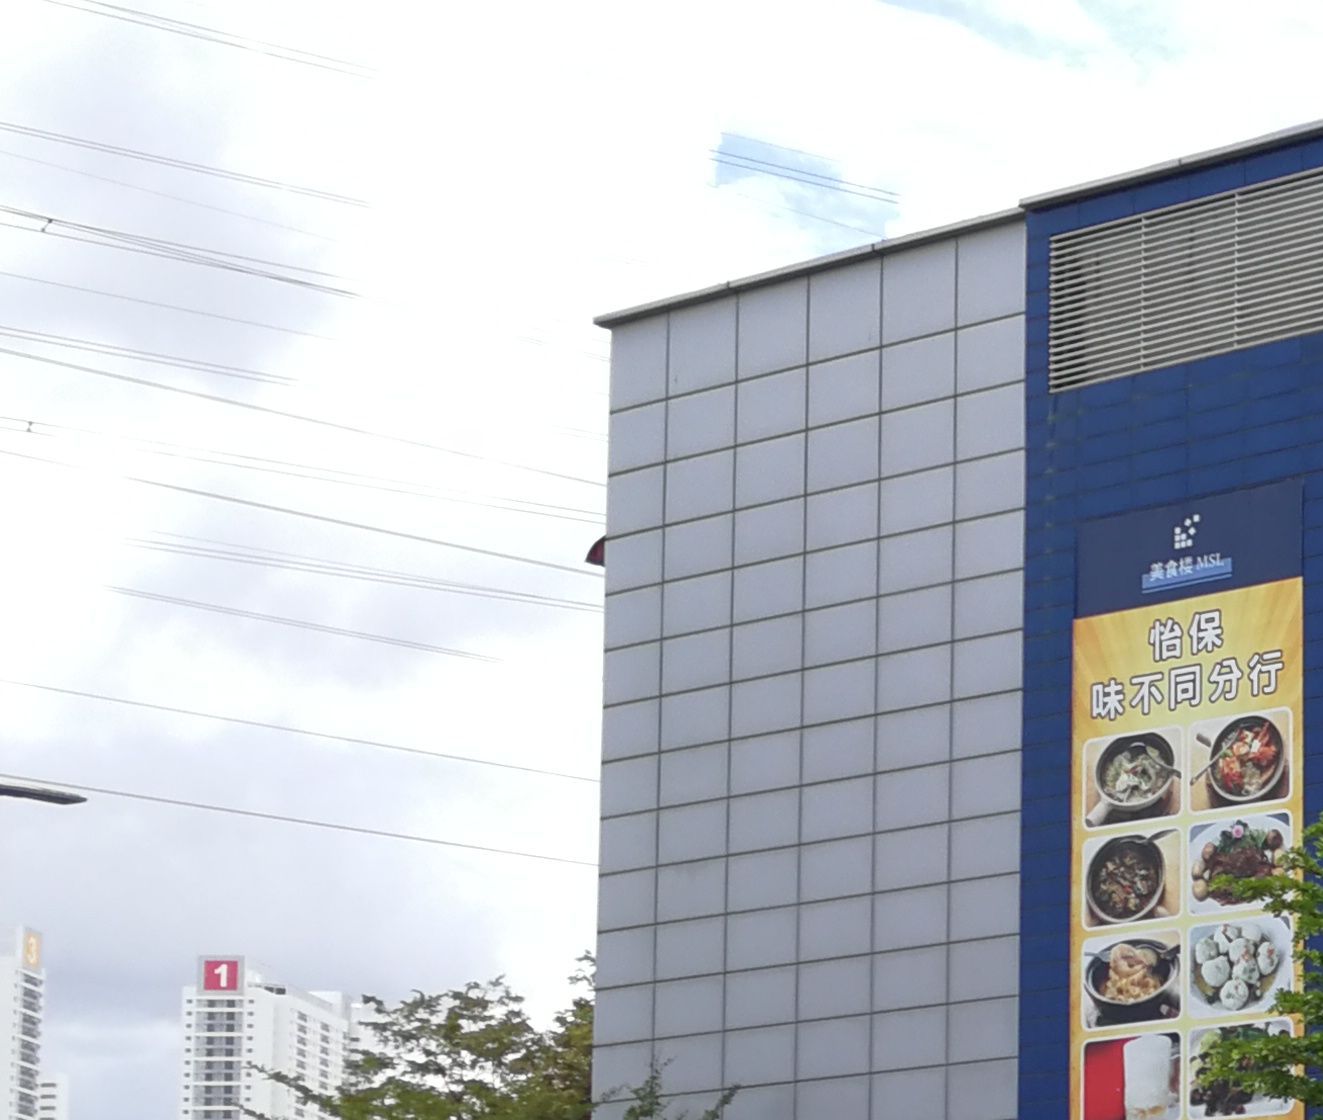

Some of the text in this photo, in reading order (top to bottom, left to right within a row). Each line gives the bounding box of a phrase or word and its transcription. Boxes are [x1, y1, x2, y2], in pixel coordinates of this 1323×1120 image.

[1196, 552, 1225, 571] MSL
[1148, 609, 1225, 662] 怡保
[1090, 650, 1285, 721] 味不同分行
[213, 963, 229, 988] 1
